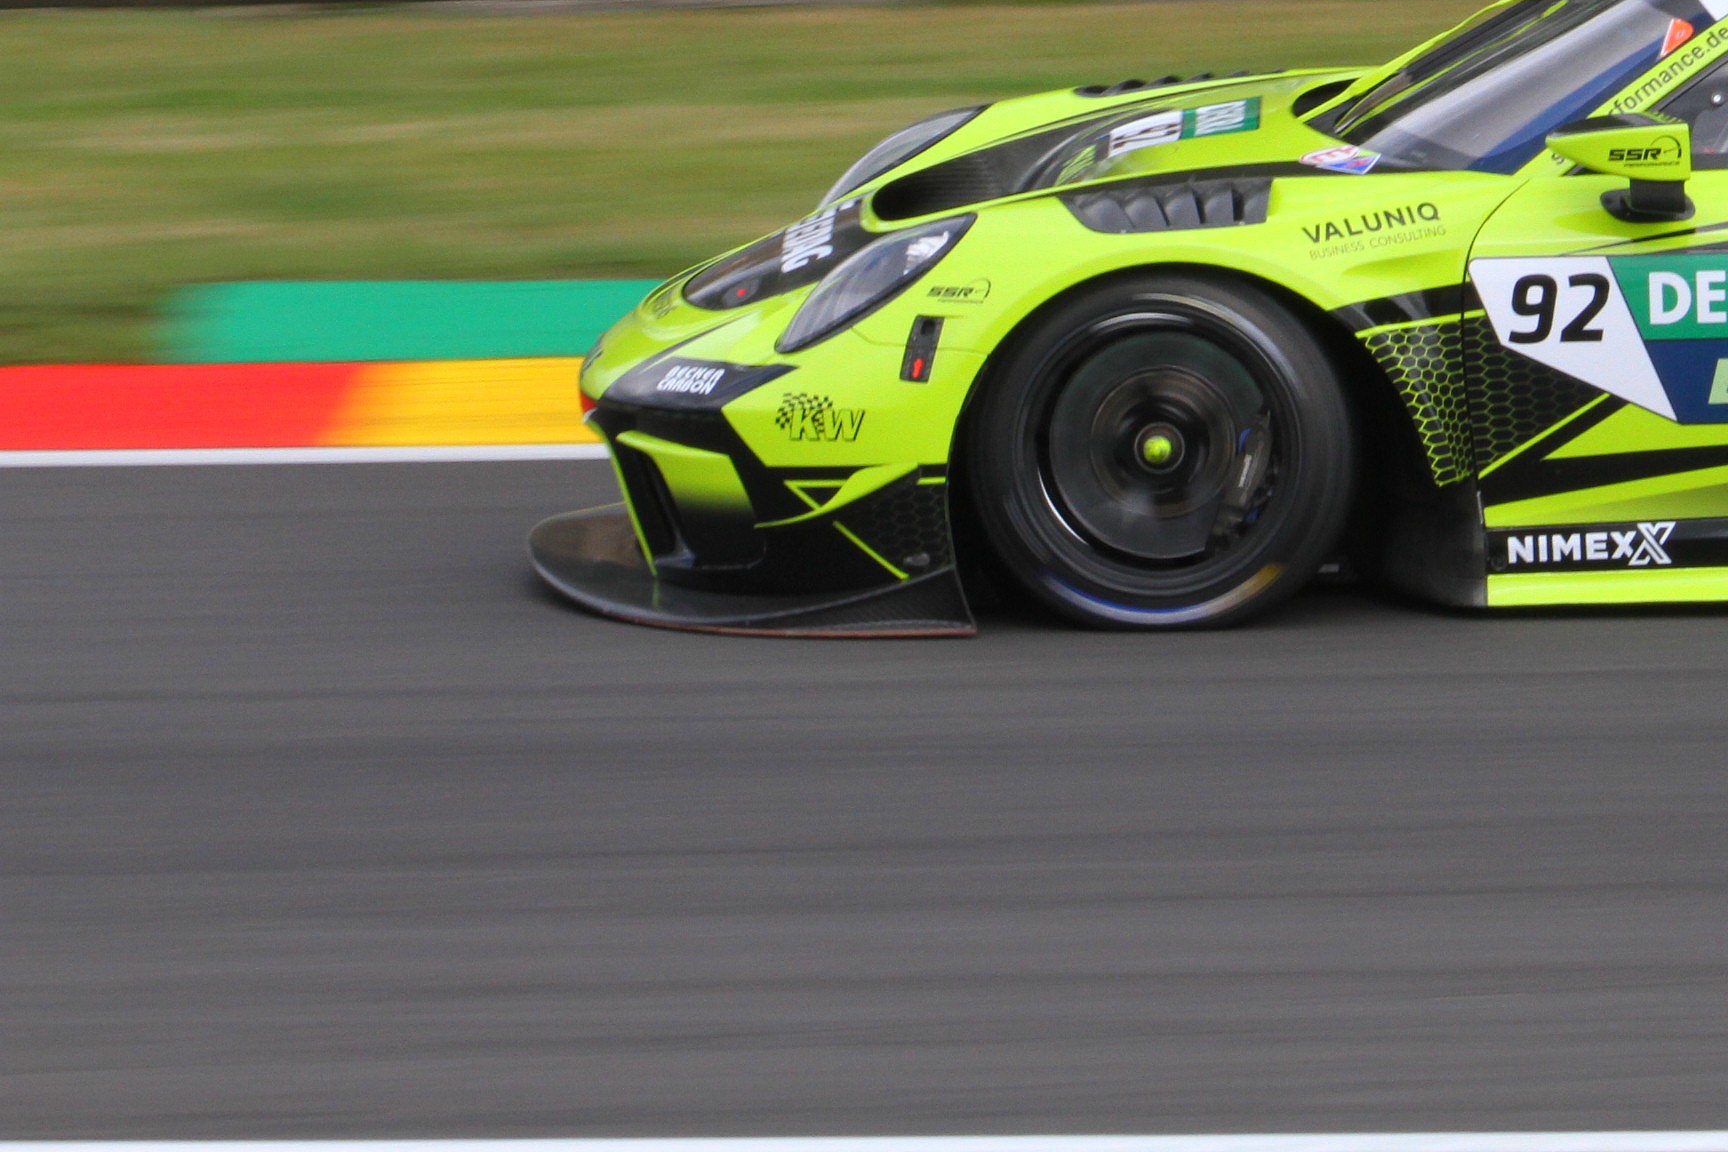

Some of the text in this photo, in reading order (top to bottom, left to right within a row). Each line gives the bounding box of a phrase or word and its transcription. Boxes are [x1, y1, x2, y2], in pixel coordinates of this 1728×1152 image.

[1608, 147, 1662, 161] SSR
[1302, 201, 1441, 244] VALUNIQ
[1309, 225, 1447, 261] BUSINESS CONSULTING
[1508, 273, 1611, 345] 92
[789, 408, 866, 442] KW
